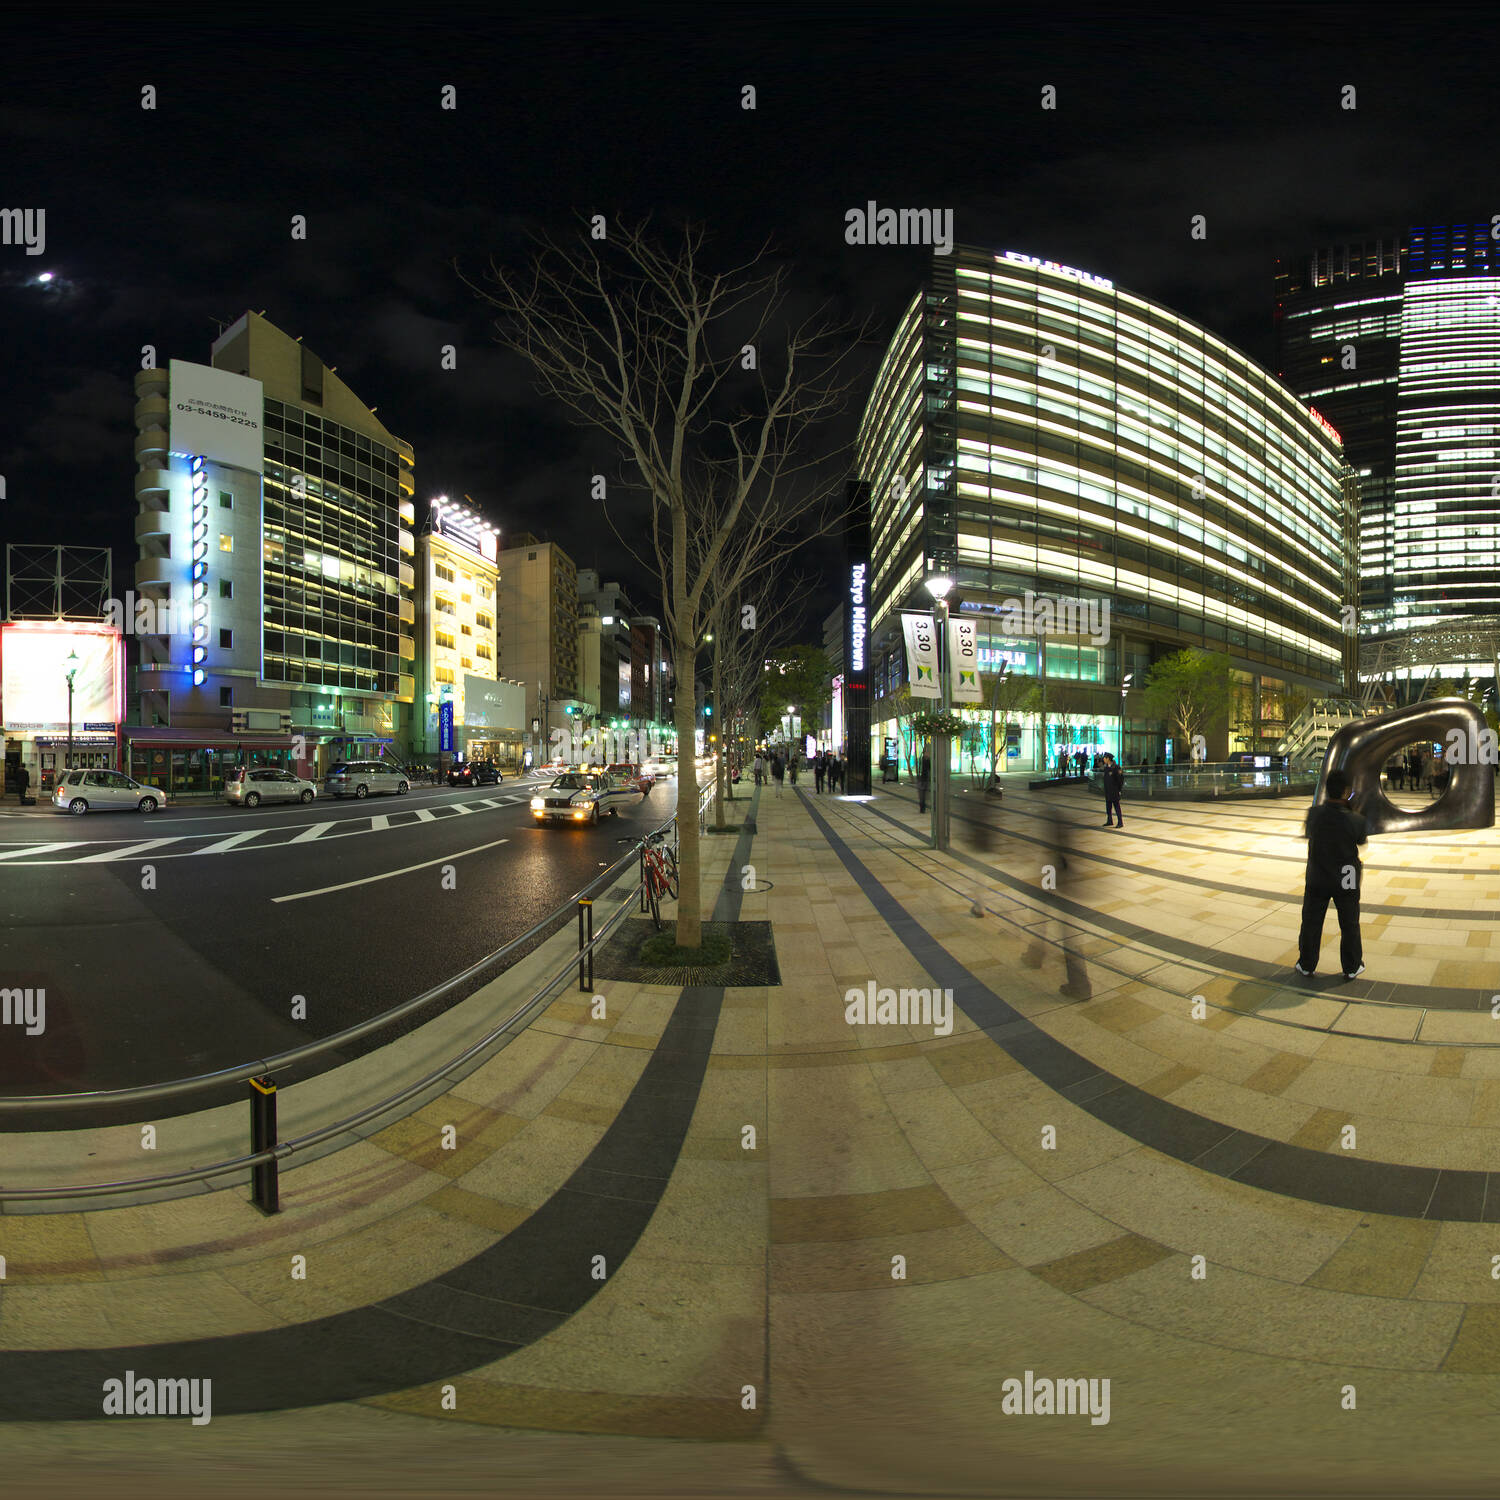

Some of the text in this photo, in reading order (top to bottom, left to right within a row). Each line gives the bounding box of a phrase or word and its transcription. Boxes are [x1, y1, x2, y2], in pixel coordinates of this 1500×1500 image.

[176, 403, 258, 429] 03-5459-2225
[850, 563, 866, 604] Tokyo
[852, 606, 867, 671] Midtown
[916, 621, 932, 653] 3.30
[959, 625, 974, 657] 3.30
